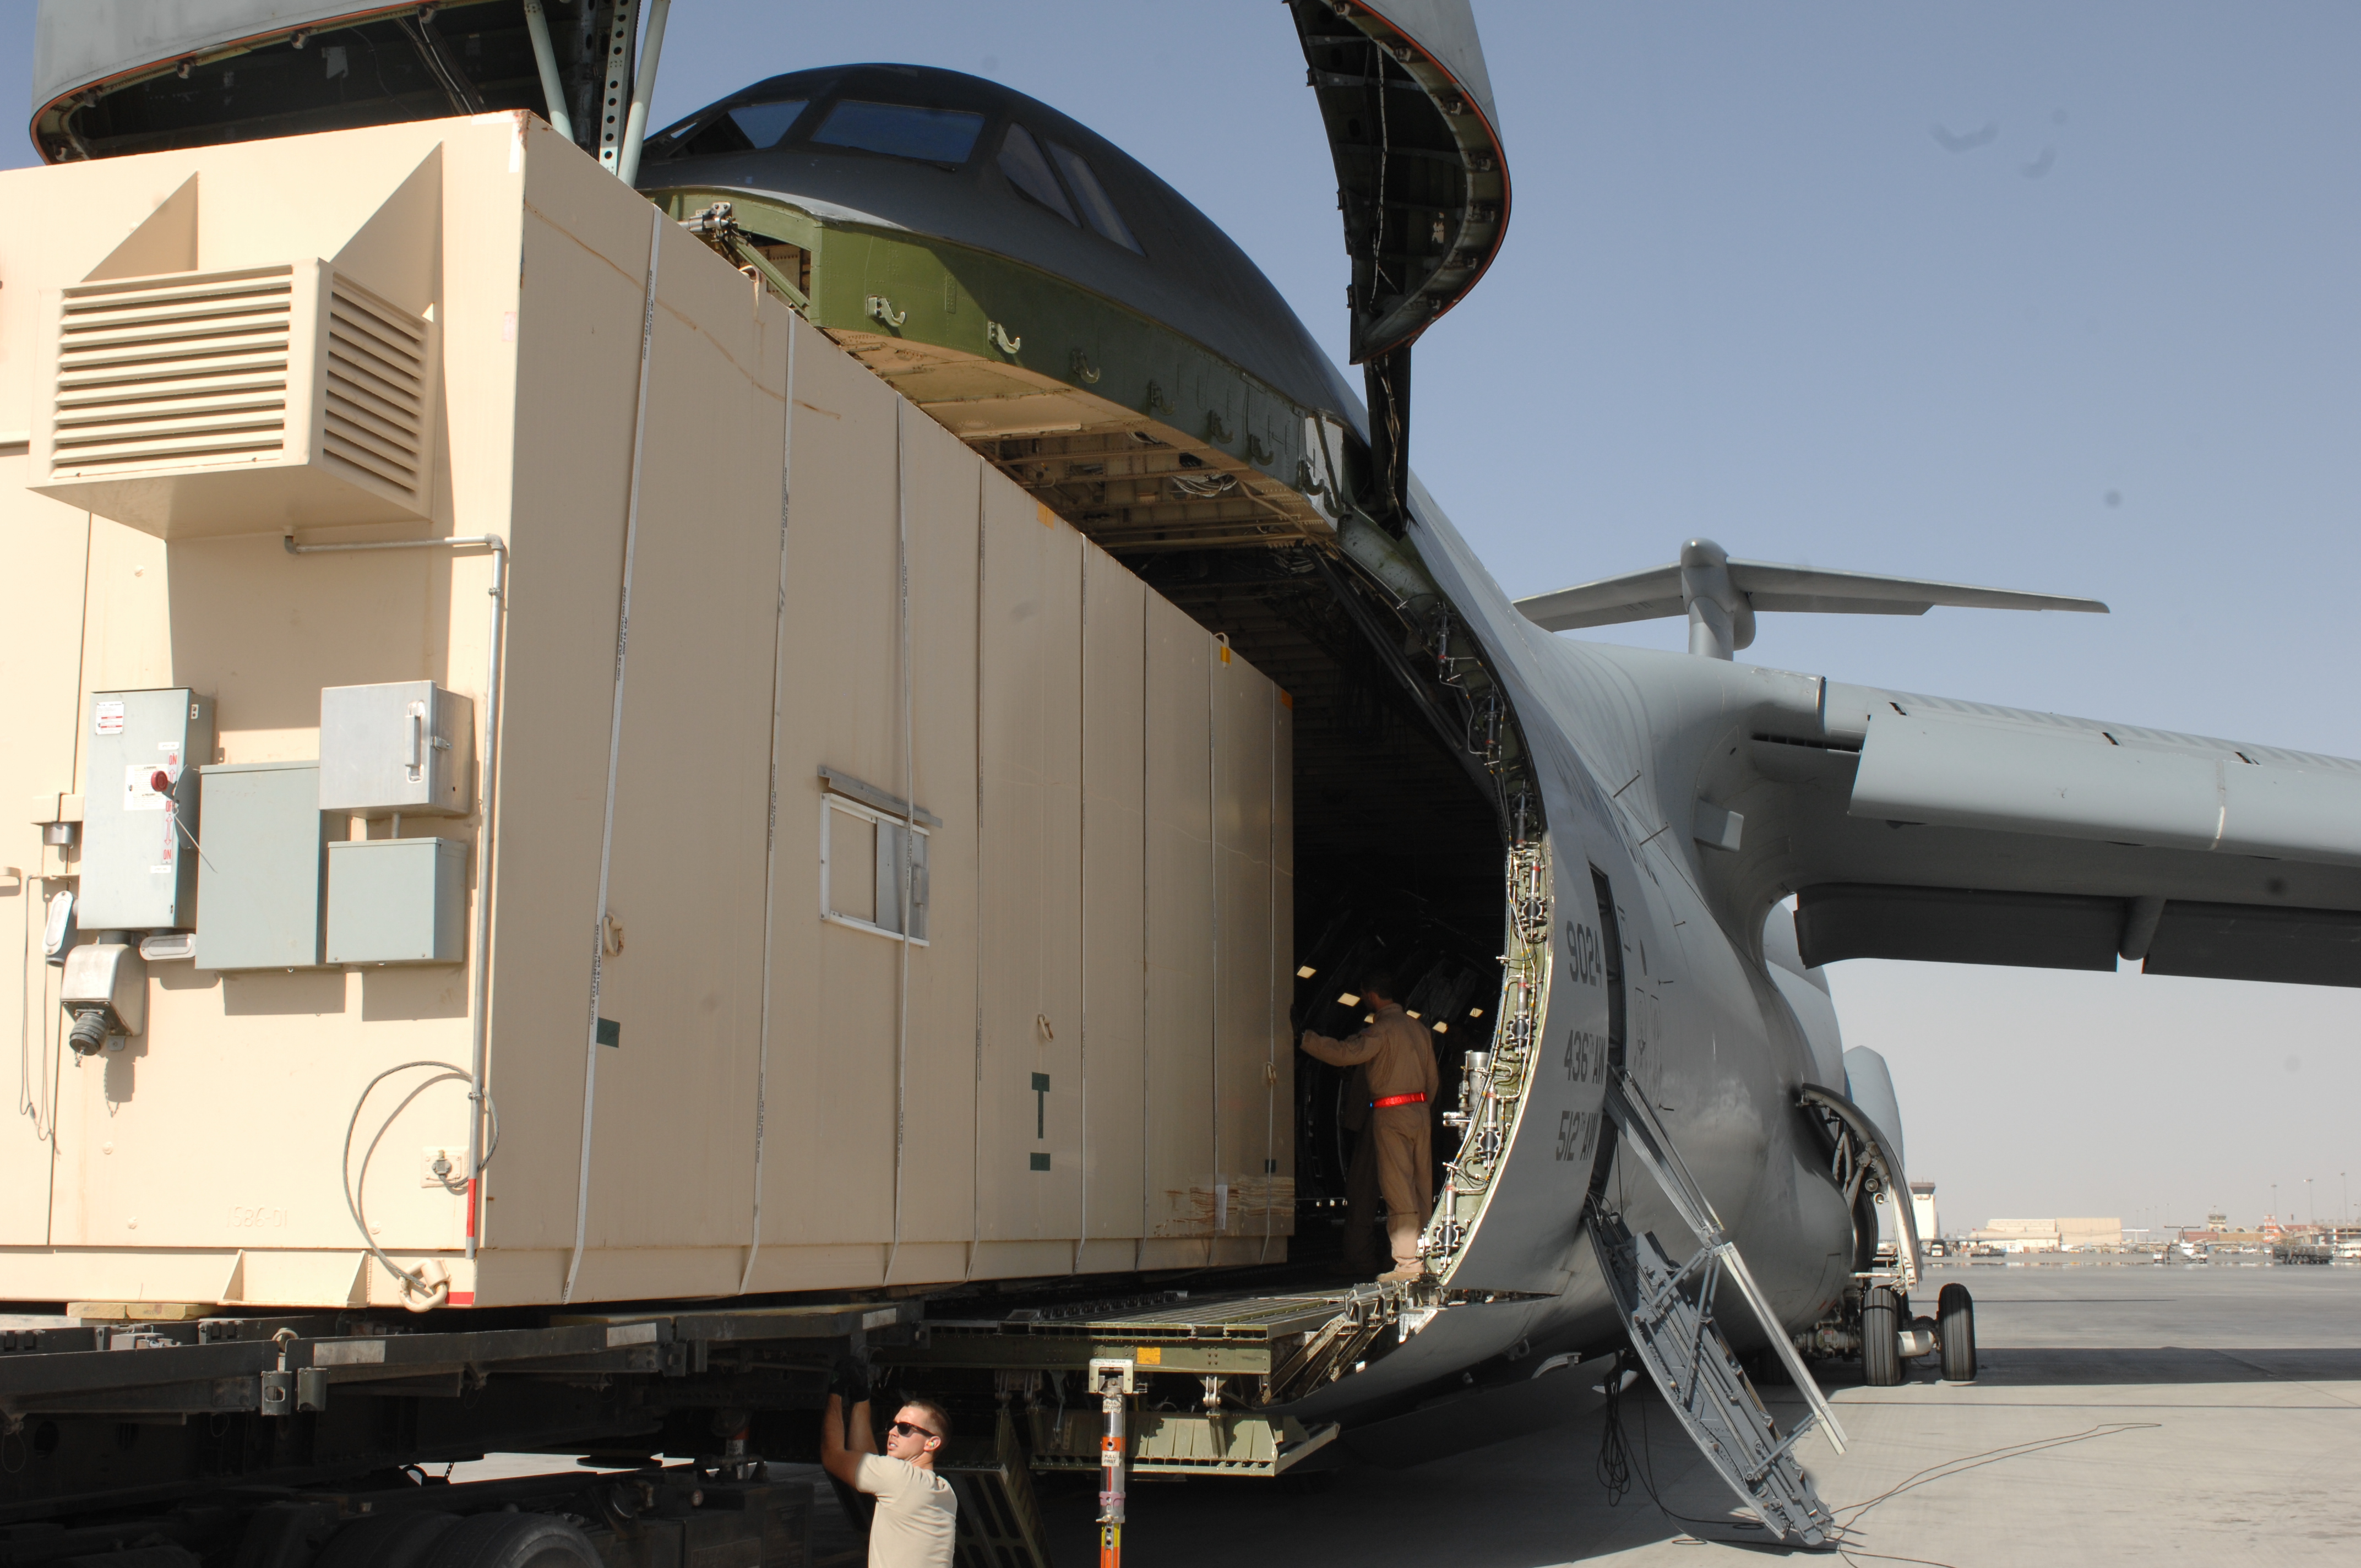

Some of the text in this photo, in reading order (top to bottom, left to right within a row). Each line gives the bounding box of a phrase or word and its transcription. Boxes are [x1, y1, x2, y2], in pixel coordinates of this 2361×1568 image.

[169, 755, 177, 765] ON
[164, 850, 171, 860] ON
[1566, 920, 1602, 988] 9024
[1592, 1036, 1606, 1085] AW
[1579, 1113, 1599, 1161] AW
[226, 1205, 287, 1229] 1586-01
